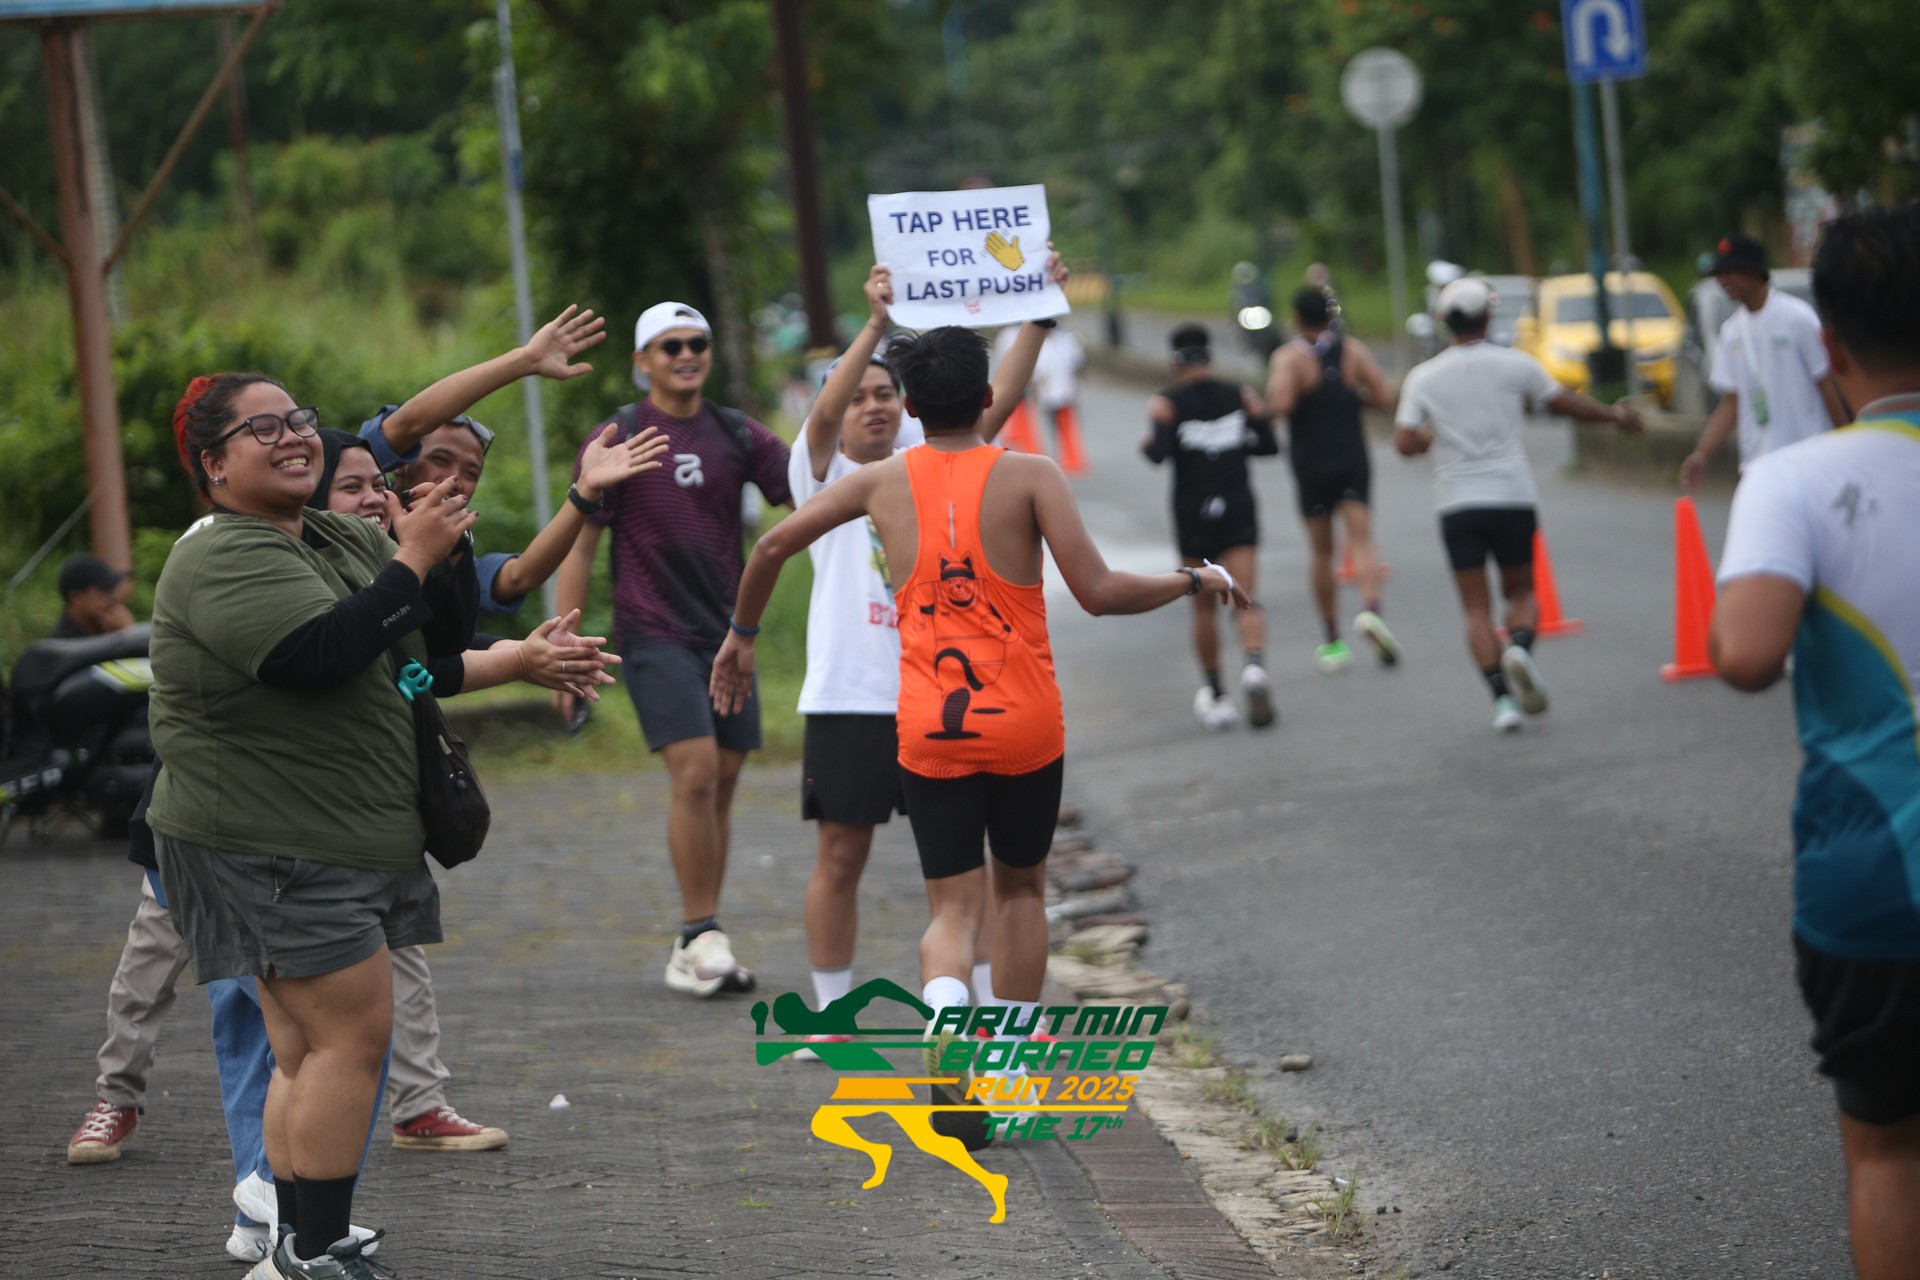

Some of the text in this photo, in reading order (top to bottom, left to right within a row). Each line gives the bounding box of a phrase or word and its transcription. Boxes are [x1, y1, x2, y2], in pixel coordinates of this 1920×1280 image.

[890, 205, 1032, 233] TAP HERE
[927, 248, 976, 267] FOR
[907, 272, 1044, 301] LAST PUSH
